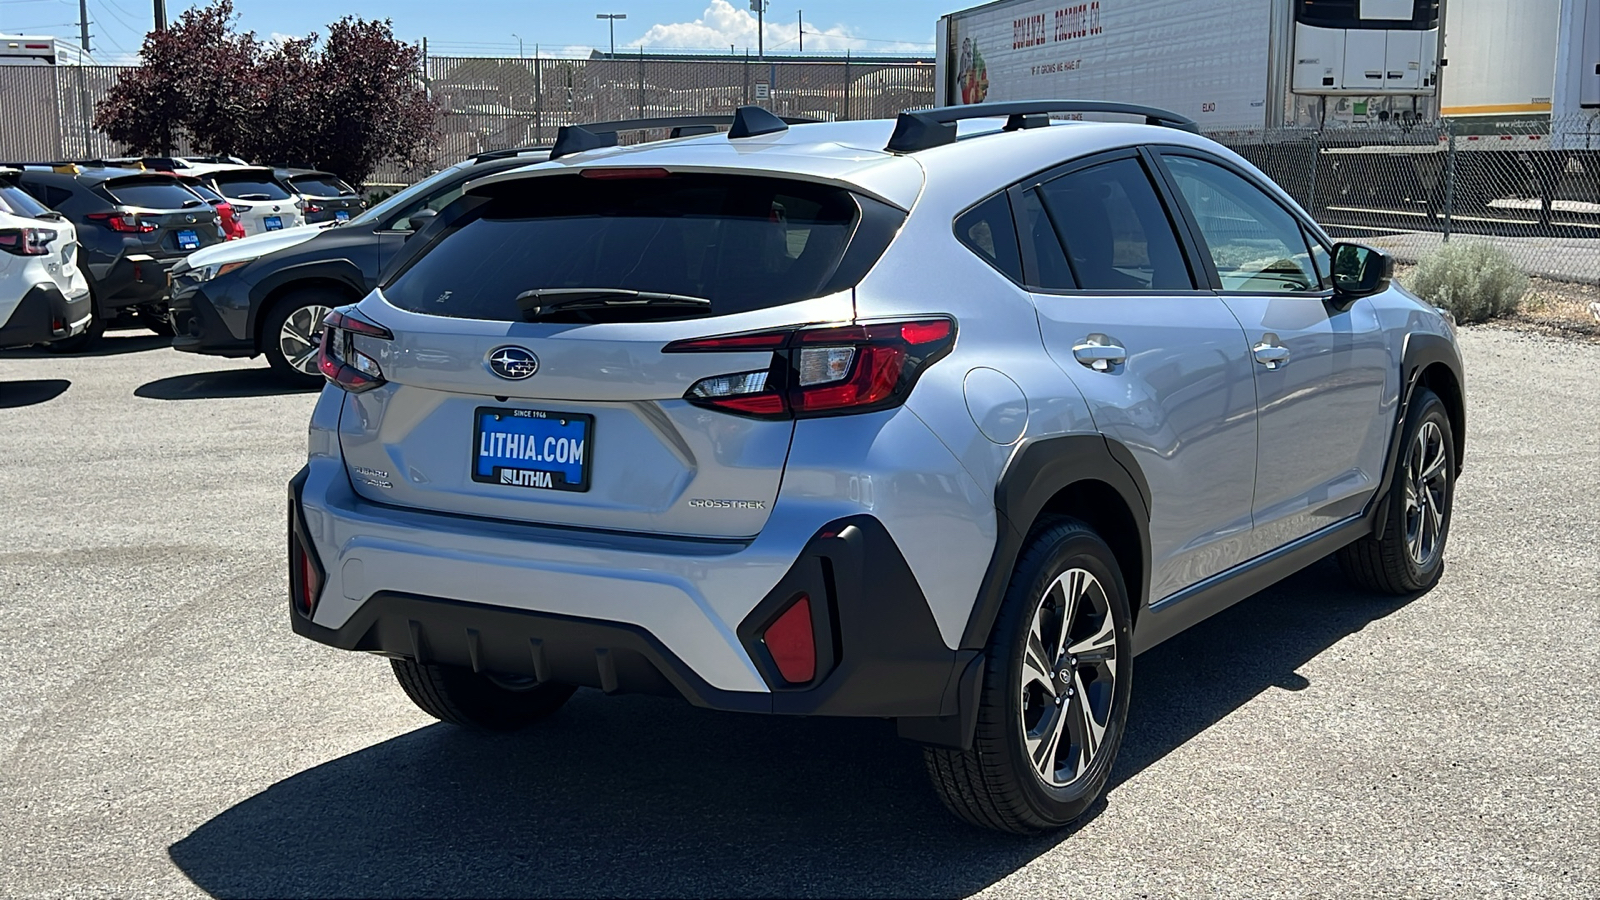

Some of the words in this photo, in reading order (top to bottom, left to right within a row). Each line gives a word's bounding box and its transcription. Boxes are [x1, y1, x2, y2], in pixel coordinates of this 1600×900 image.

[1013, 13, 1046, 50] BONANZA
[1055, 4, 1087, 42] PRODUCE
[1090, 1, 1102, 35] CO.
[1202, 102, 1216, 113] ELKO
[513, 410, 532, 418] SINCE
[533, 411, 546, 419] 1946
[480, 431, 584, 466] LITHIA.COM
[354, 465, 389, 479] SUBARU
[512, 469, 553, 488] LITHIA
[688, 499, 765, 509] CROSSTREK
